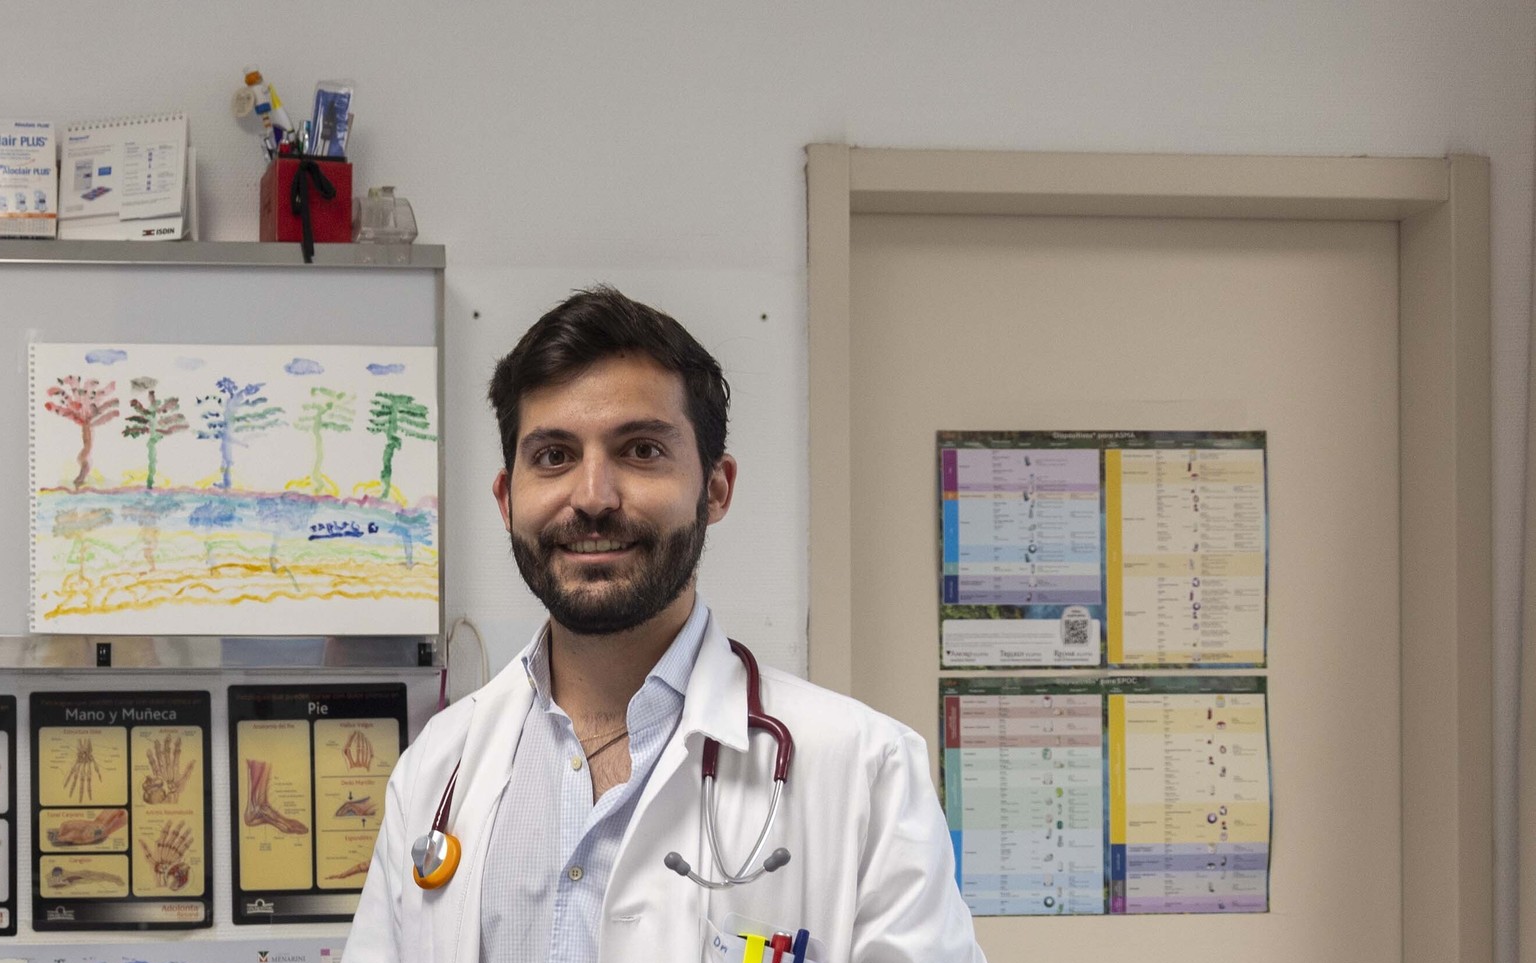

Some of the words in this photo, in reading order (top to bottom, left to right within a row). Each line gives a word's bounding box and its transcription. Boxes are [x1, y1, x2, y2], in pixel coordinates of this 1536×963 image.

[20, 136, 47, 147] PLUS
[2, 166, 30, 175] Aloclair
[33, 167, 51, 176] PLUS
[155, 227, 175, 235] ISDIN
[1116, 677, 1137, 685] EPOC
[307, 702, 329, 715] Pie
[65, 708, 105, 721] Mano
[109, 710, 118, 725] y
[122, 707, 177, 721] Muñeca
[161, 904, 199, 912] Adolonta
